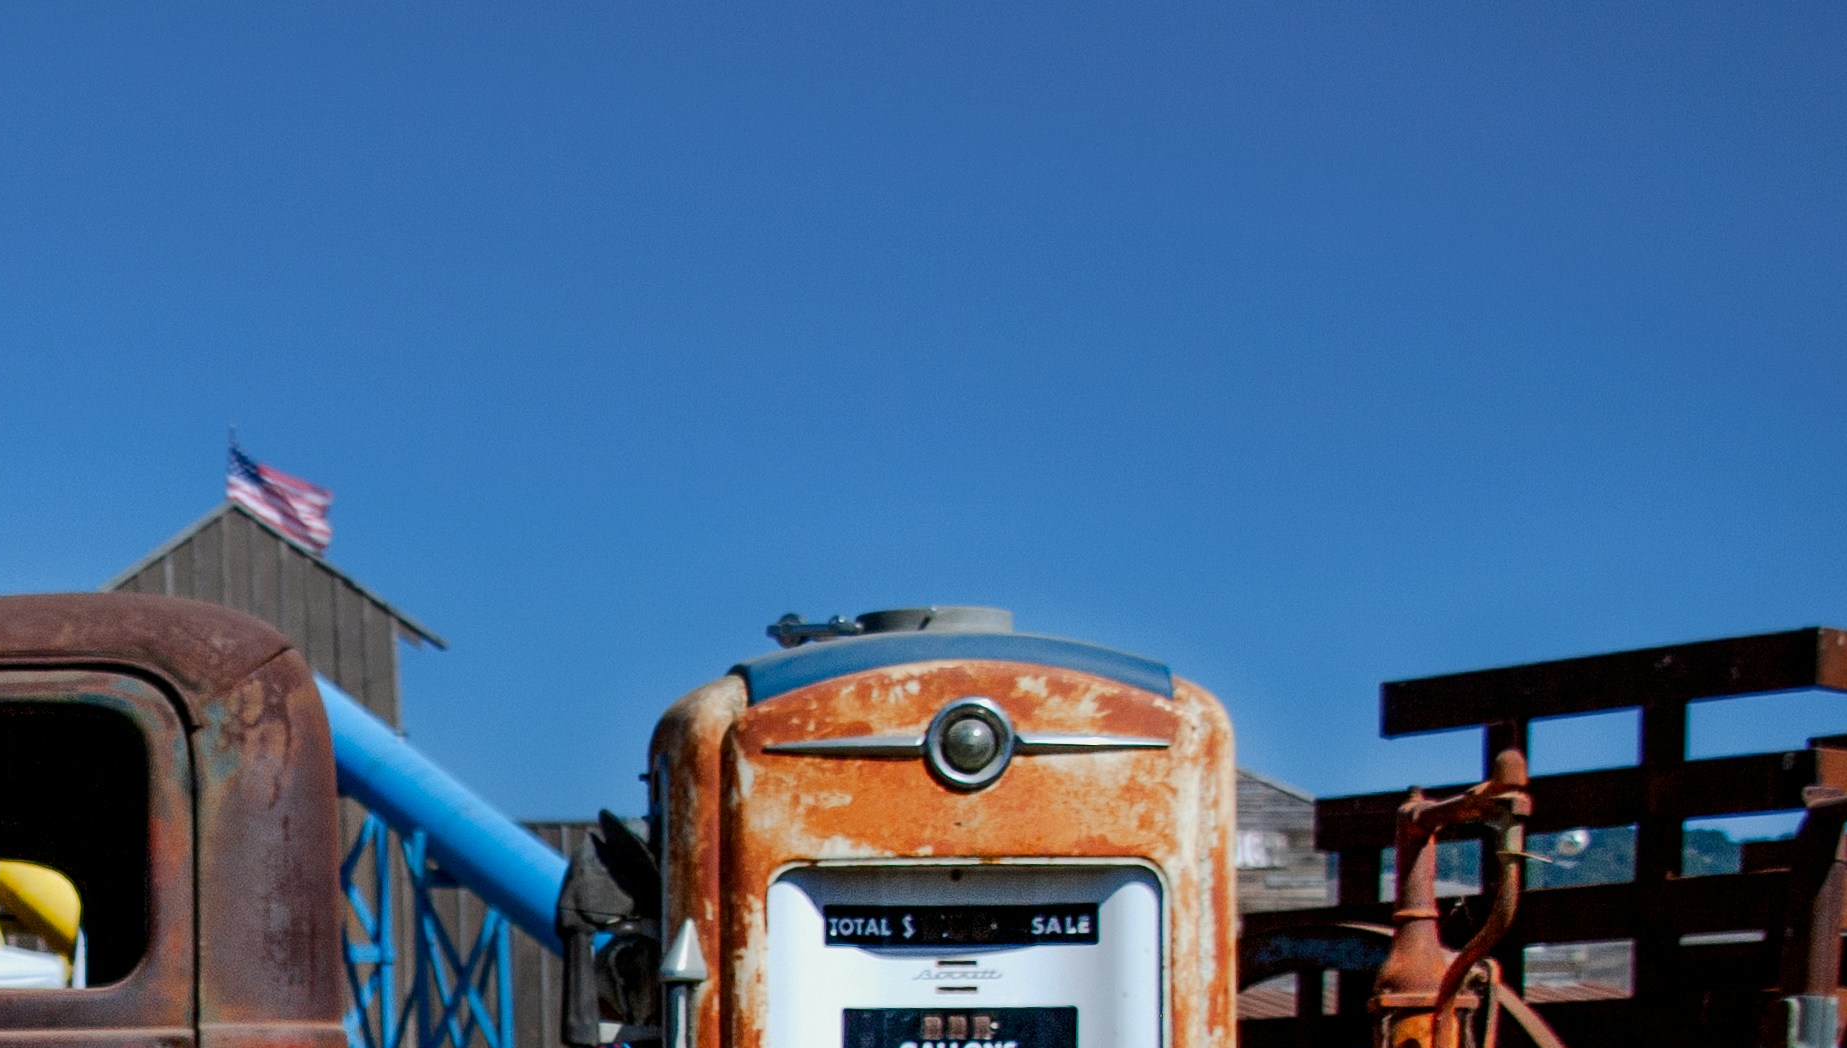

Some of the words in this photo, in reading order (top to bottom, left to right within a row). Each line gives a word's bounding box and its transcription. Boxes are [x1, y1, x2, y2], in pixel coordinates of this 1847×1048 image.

[829, 917, 892, 936] TOTAL
[902, 914, 915, 938] $
[1031, 914, 1091, 935] SALE
